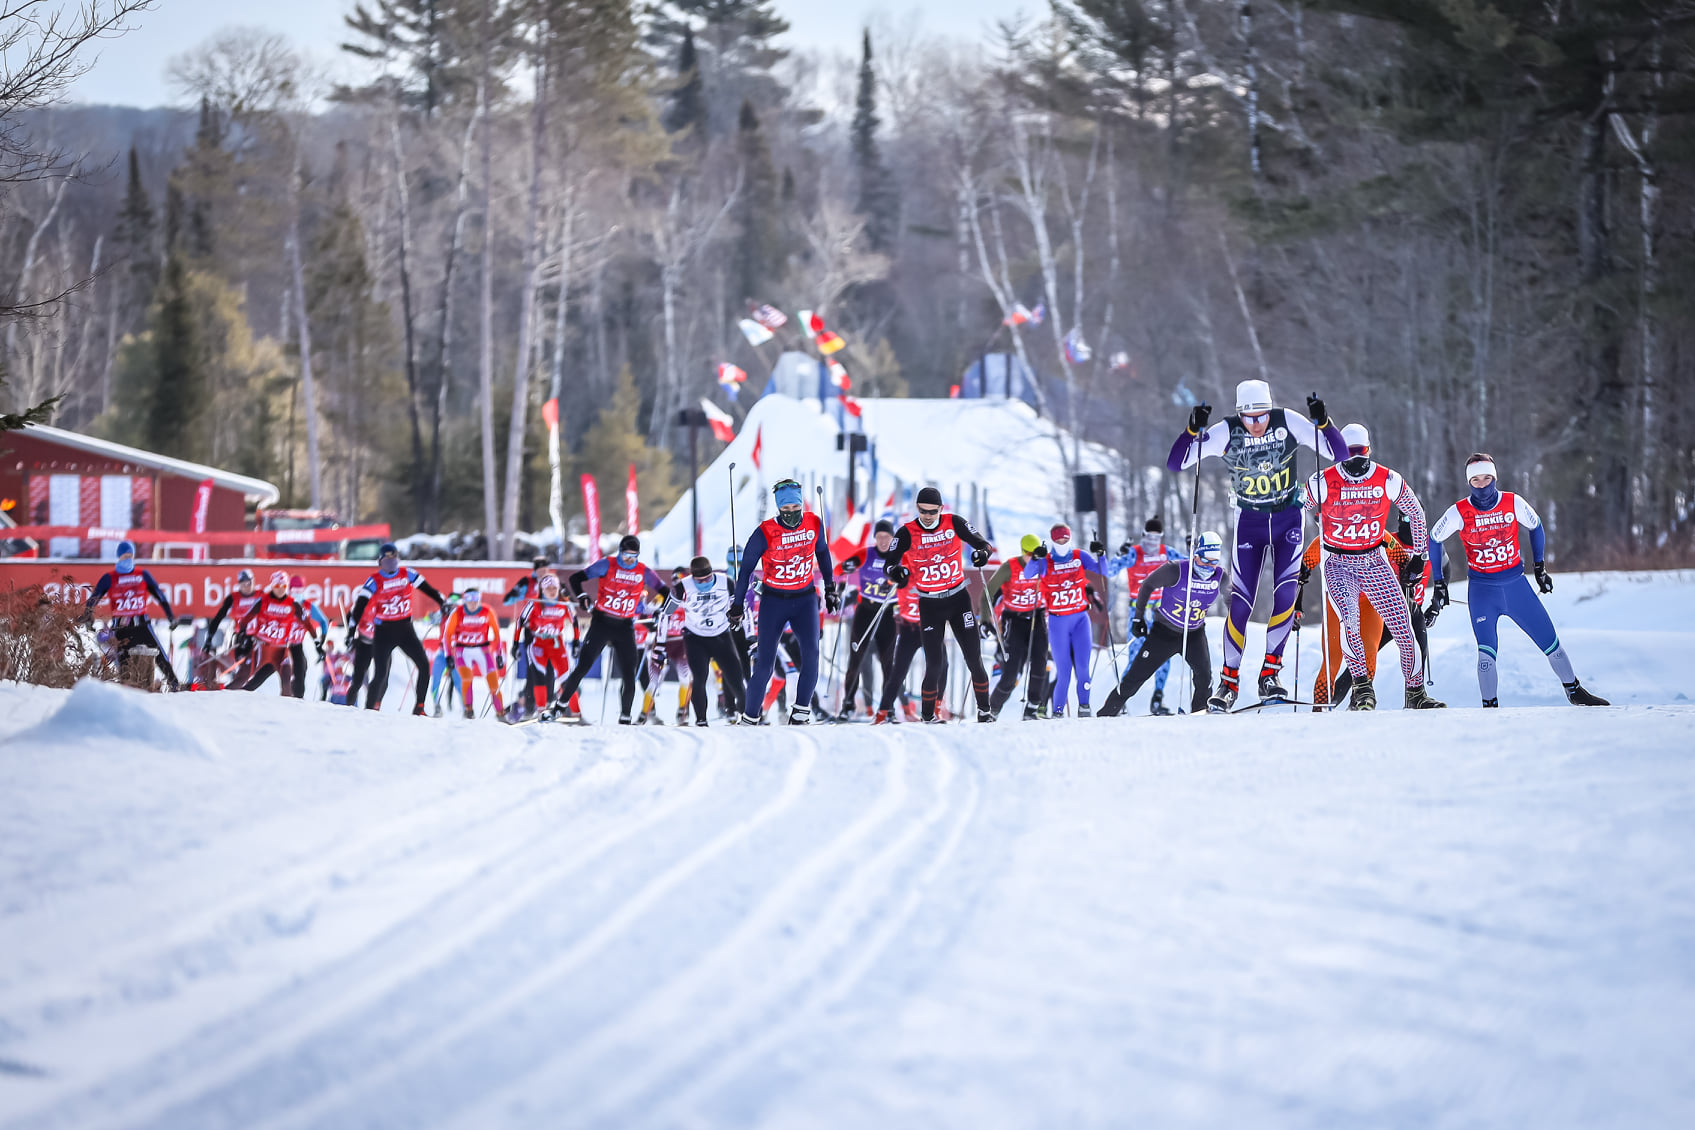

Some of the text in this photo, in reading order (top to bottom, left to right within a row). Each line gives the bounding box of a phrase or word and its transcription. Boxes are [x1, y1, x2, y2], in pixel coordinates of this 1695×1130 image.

[1244, 432, 1276, 447] BIRKIE
[1242, 467, 1290, 495] 2017
[1341, 490, 1374, 500] BIRKIE
[1475, 515, 1505, 527] BIRKIE
[1331, 521, 1380, 540] 2449
[781, 533, 807, 545] BIRKIE
[921, 533, 947, 544] BIRKIE
[1473, 540, 1514, 563] 2585
[775, 559, 812, 579] 2545
[919, 560, 960, 582] 2592
[115, 596, 144, 611] 2425
[604, 595, 635, 611] 2619
[1011, 591, 1042, 605] 2551
[1051, 587, 1082, 606] 2523
[382, 600, 411, 615] 2512
